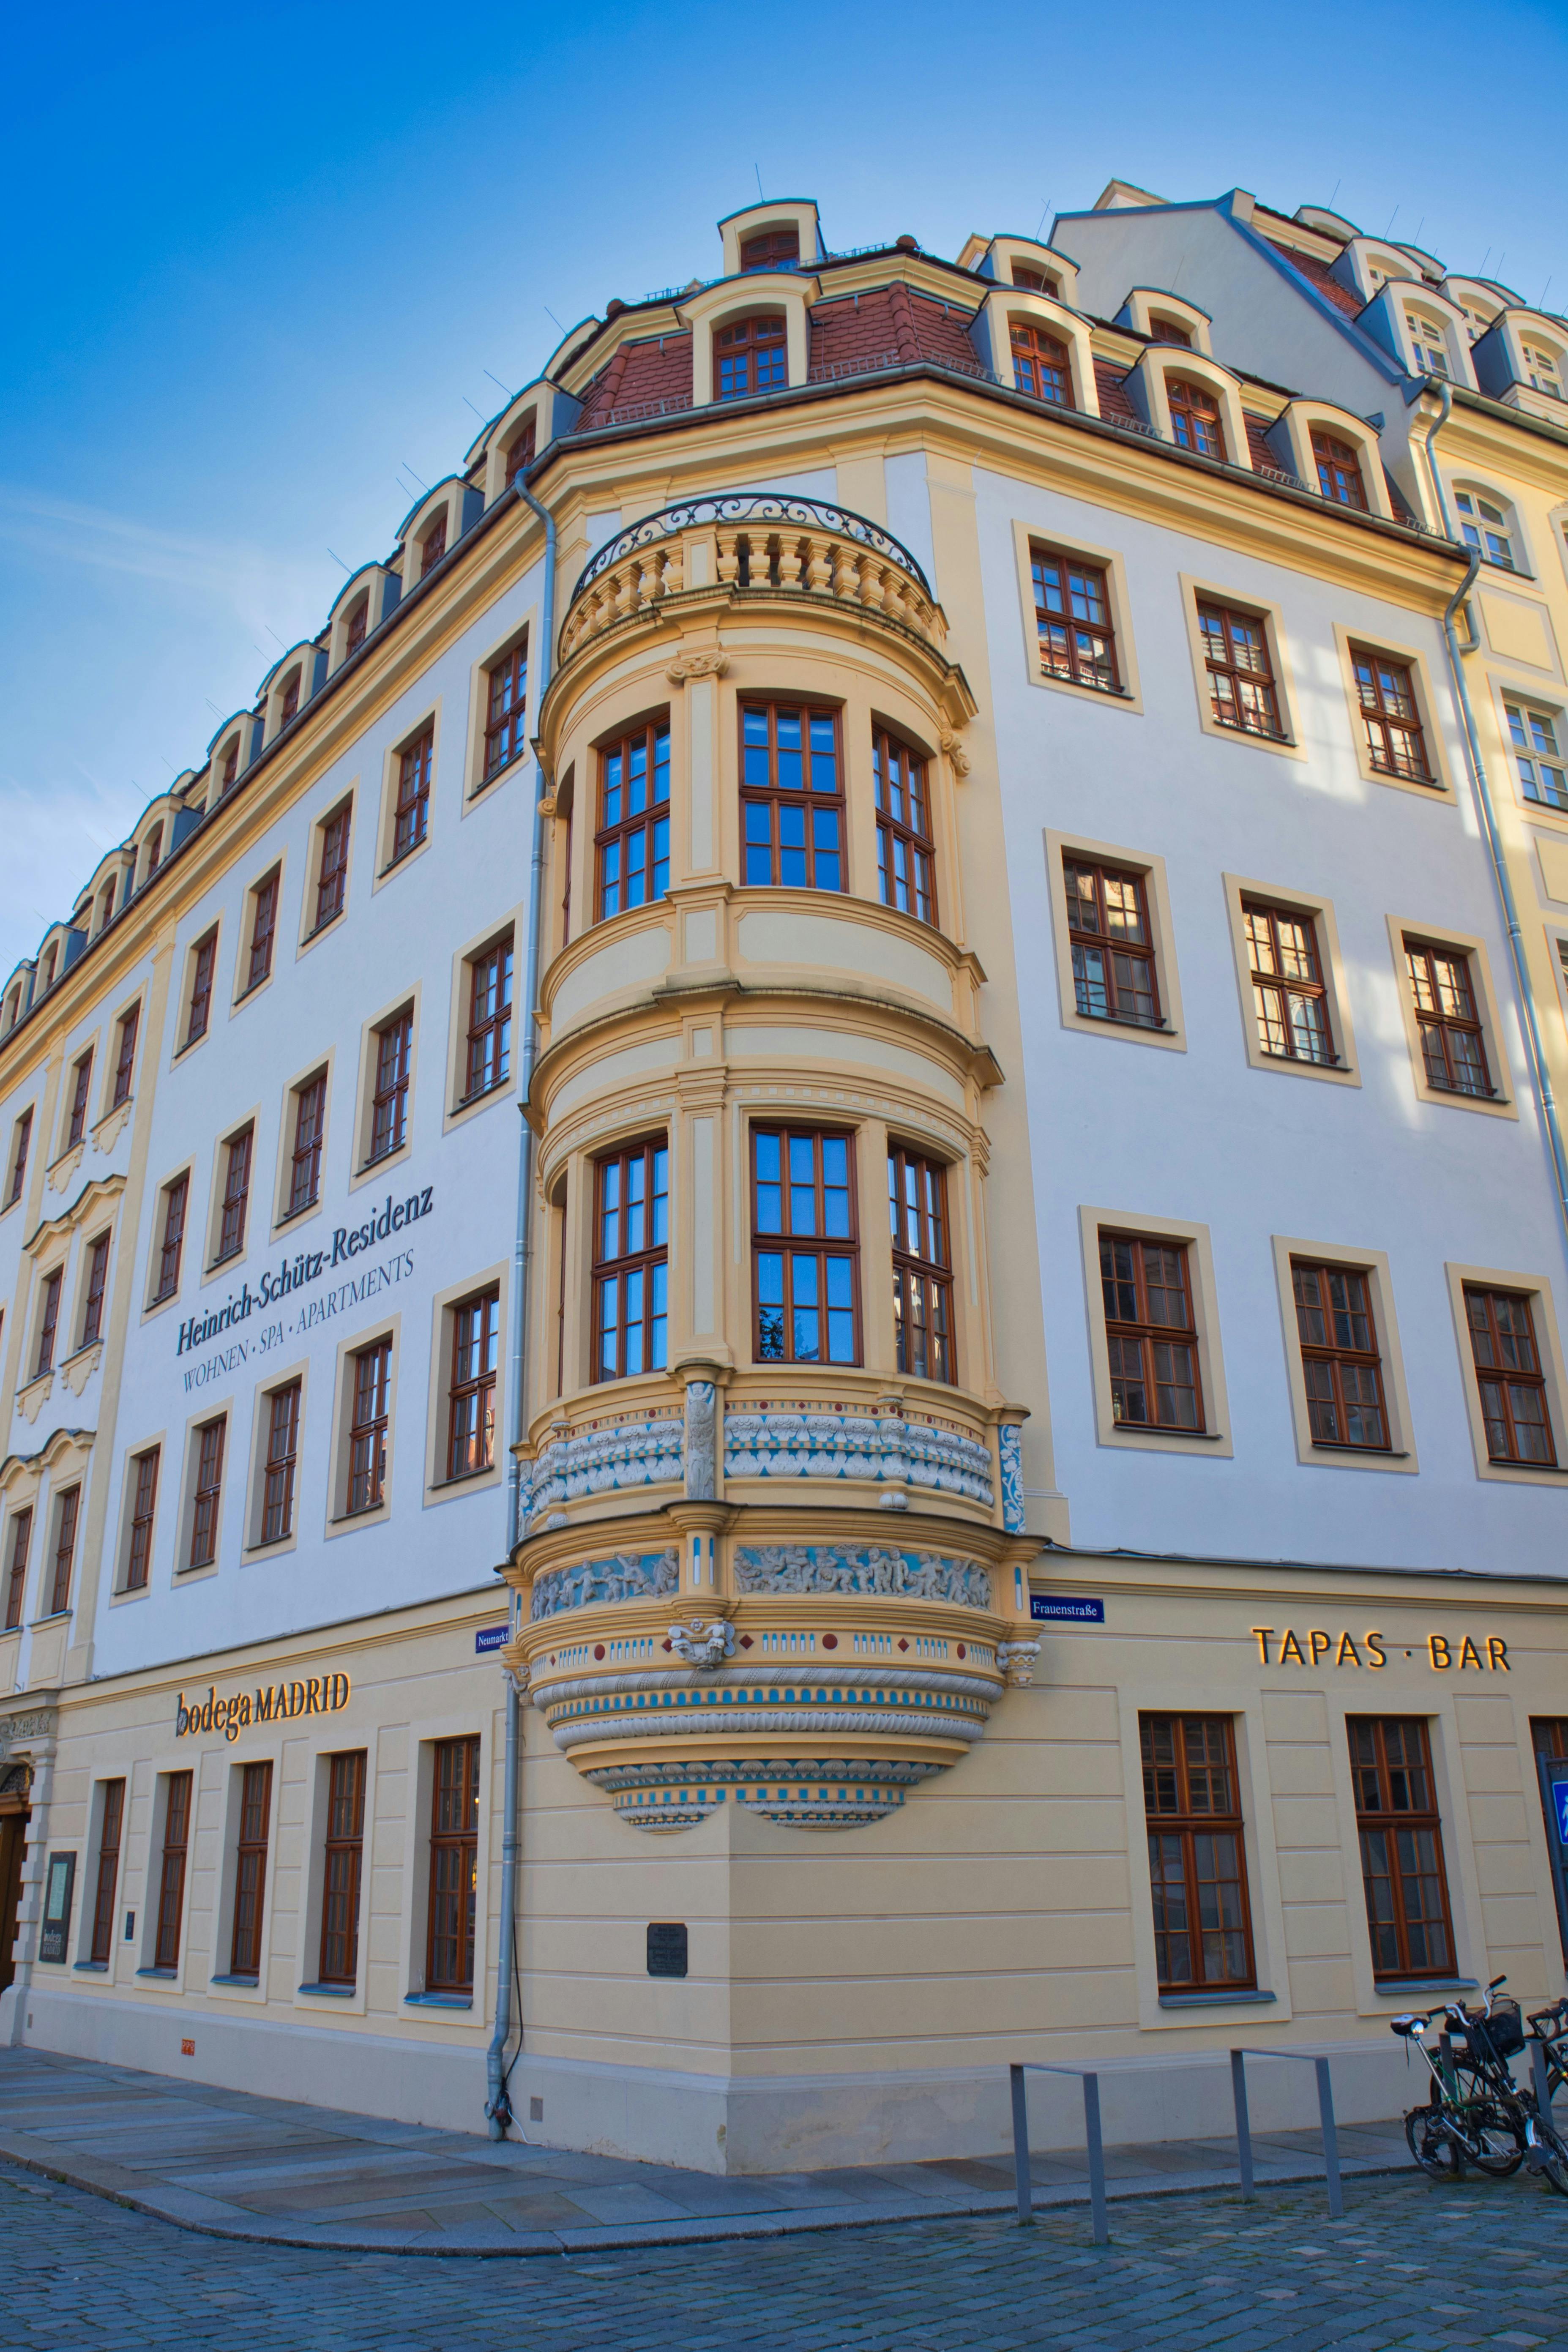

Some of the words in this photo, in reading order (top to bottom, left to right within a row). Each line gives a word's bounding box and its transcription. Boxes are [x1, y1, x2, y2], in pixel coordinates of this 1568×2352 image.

[176, 1186, 434, 1356] Heinrich-Schütz-Residenz
[184, 1339, 249, 1393] WOHNEN
[260, 1320, 284, 1354] SPA
[295, 1248, 414, 1335] APARTMENTS
[1033, 1601, 1097, 1616] Frauenstraße
[478, 1631, 508, 1647] Neumarkt
[1252, 1628, 1387, 1668] TAPAS
[1429, 1635, 1511, 1671] BAR
[176, 1686, 251, 1742] bodega
[254, 1673, 350, 1722] MADRID
